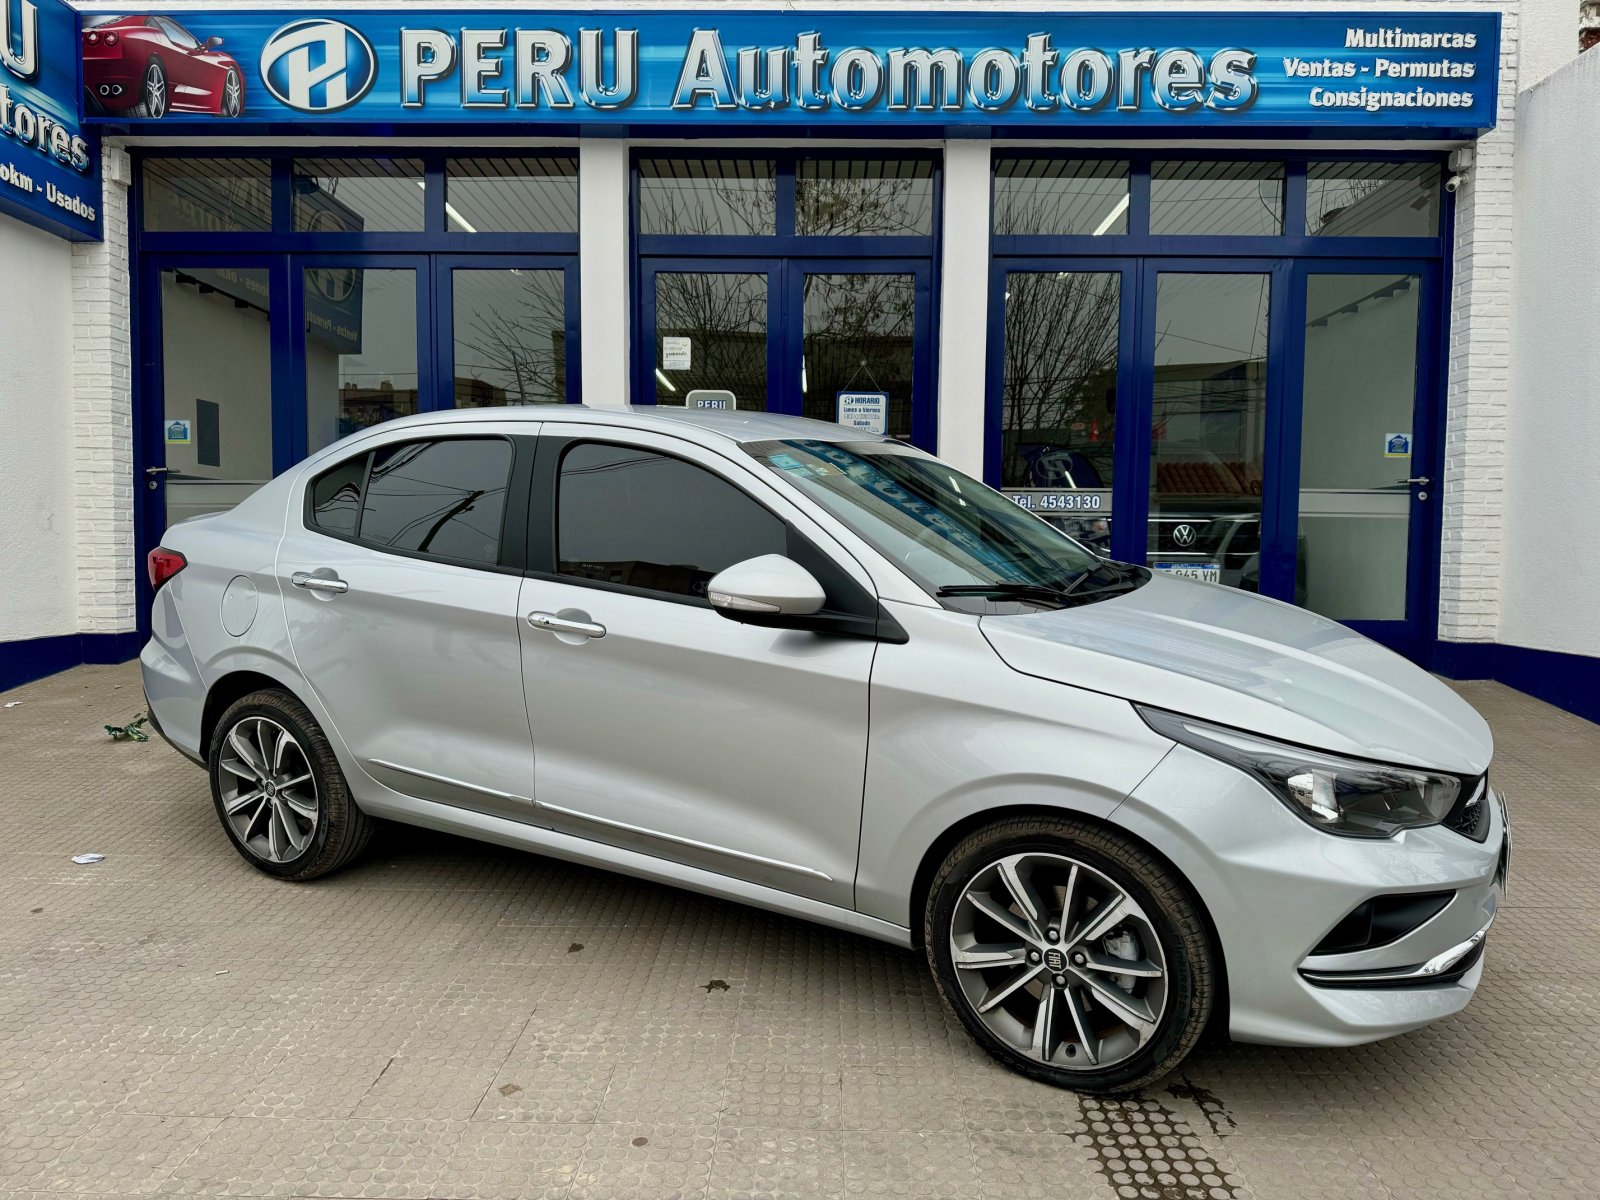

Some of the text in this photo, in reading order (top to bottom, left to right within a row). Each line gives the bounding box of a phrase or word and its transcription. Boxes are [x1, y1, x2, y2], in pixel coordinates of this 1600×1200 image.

[1344, 27, 1477, 49] Multimarcas
[401, 27, 639, 110] PERU
[671, 27, 1260, 112] Automotores
[1283, 56, 1356, 78] Ventas
[1374, 57, 1475, 78] Permutas
[1309, 86, 1474, 111] Consignaciones
[46, 180, 96, 221] Usados
[1012, 495, 1100, 509] Tel. 4543130
[1048, 951, 1062, 969] FIAT
